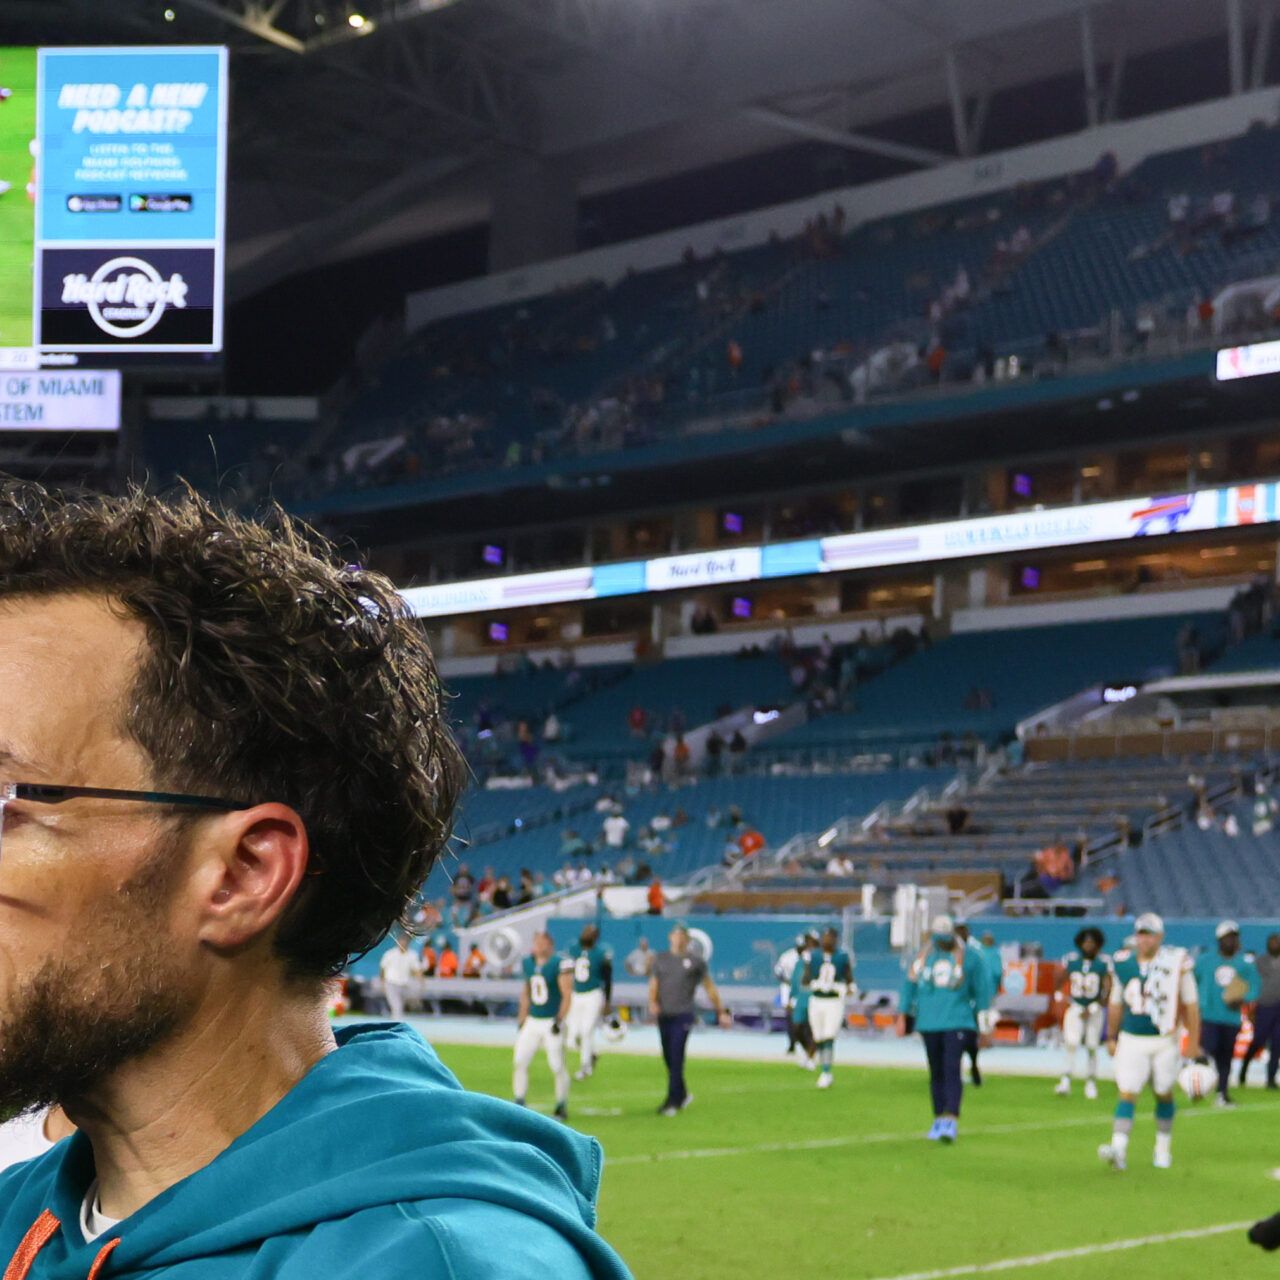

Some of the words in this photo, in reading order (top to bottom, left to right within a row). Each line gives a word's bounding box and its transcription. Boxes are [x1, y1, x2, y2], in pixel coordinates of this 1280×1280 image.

[57, 83, 121, 109] NEED
[125, 83, 148, 108] A
[149, 82, 208, 108] NEW
[72, 108, 193, 134] PODCAST?
[61, 273, 128, 303] Hard
[124, 273, 188, 308] Rock
[7, 378, 33, 396] OF
[39, 378, 106, 396] MIAMI
